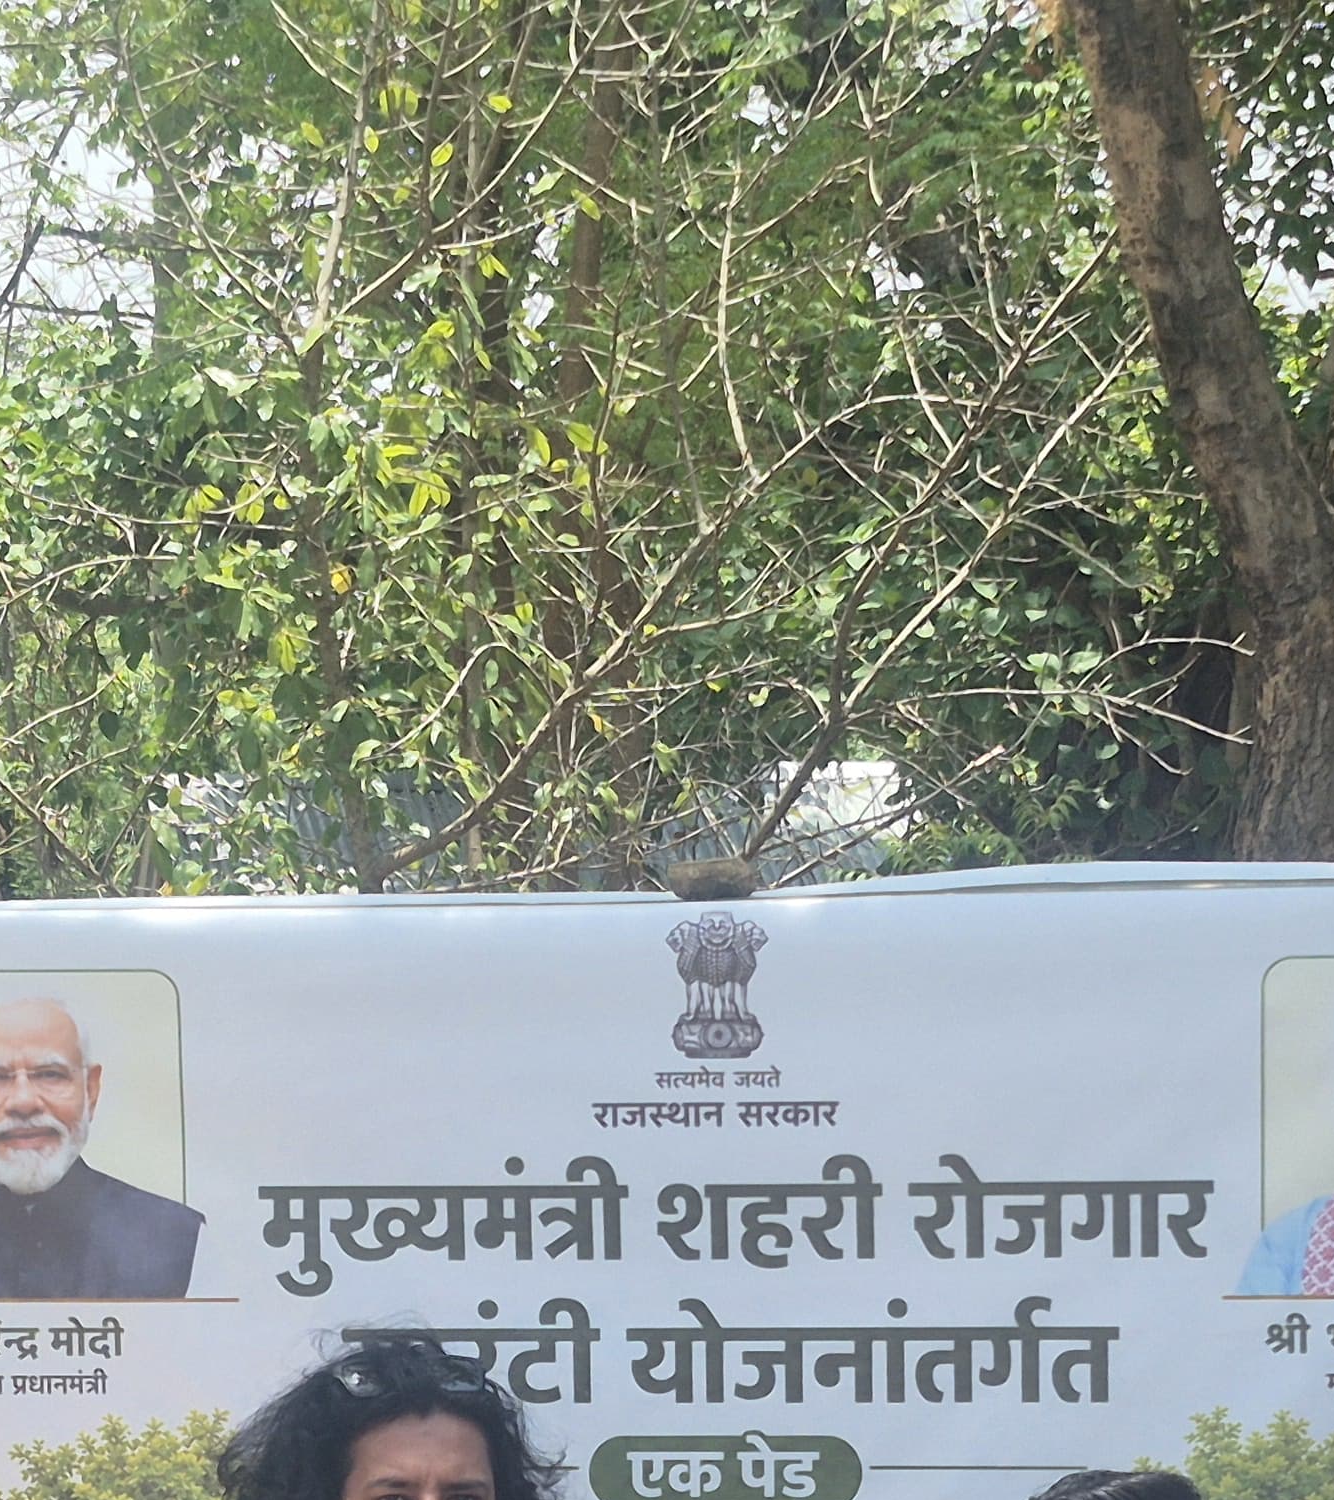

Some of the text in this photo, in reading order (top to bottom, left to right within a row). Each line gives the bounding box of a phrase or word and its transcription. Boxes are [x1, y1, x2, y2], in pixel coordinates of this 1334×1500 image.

[654, 1064, 782, 1089] सत्यमेव जयते
[591, 1100, 840, 1129] राजस्थान सरकार
[258, 1154, 1215, 1297] मुख्यमंत्री शहरी रोजगार
[49, 1316, 125, 1359] मोदी
[626, 1296, 1120, 1403] योजनांतर्गत
[1264, 1312, 1311, 1355] श्री
[11, 1367, 108, 1395] प्रधानमंत्री
[627, 1451, 725, 1498] एक
